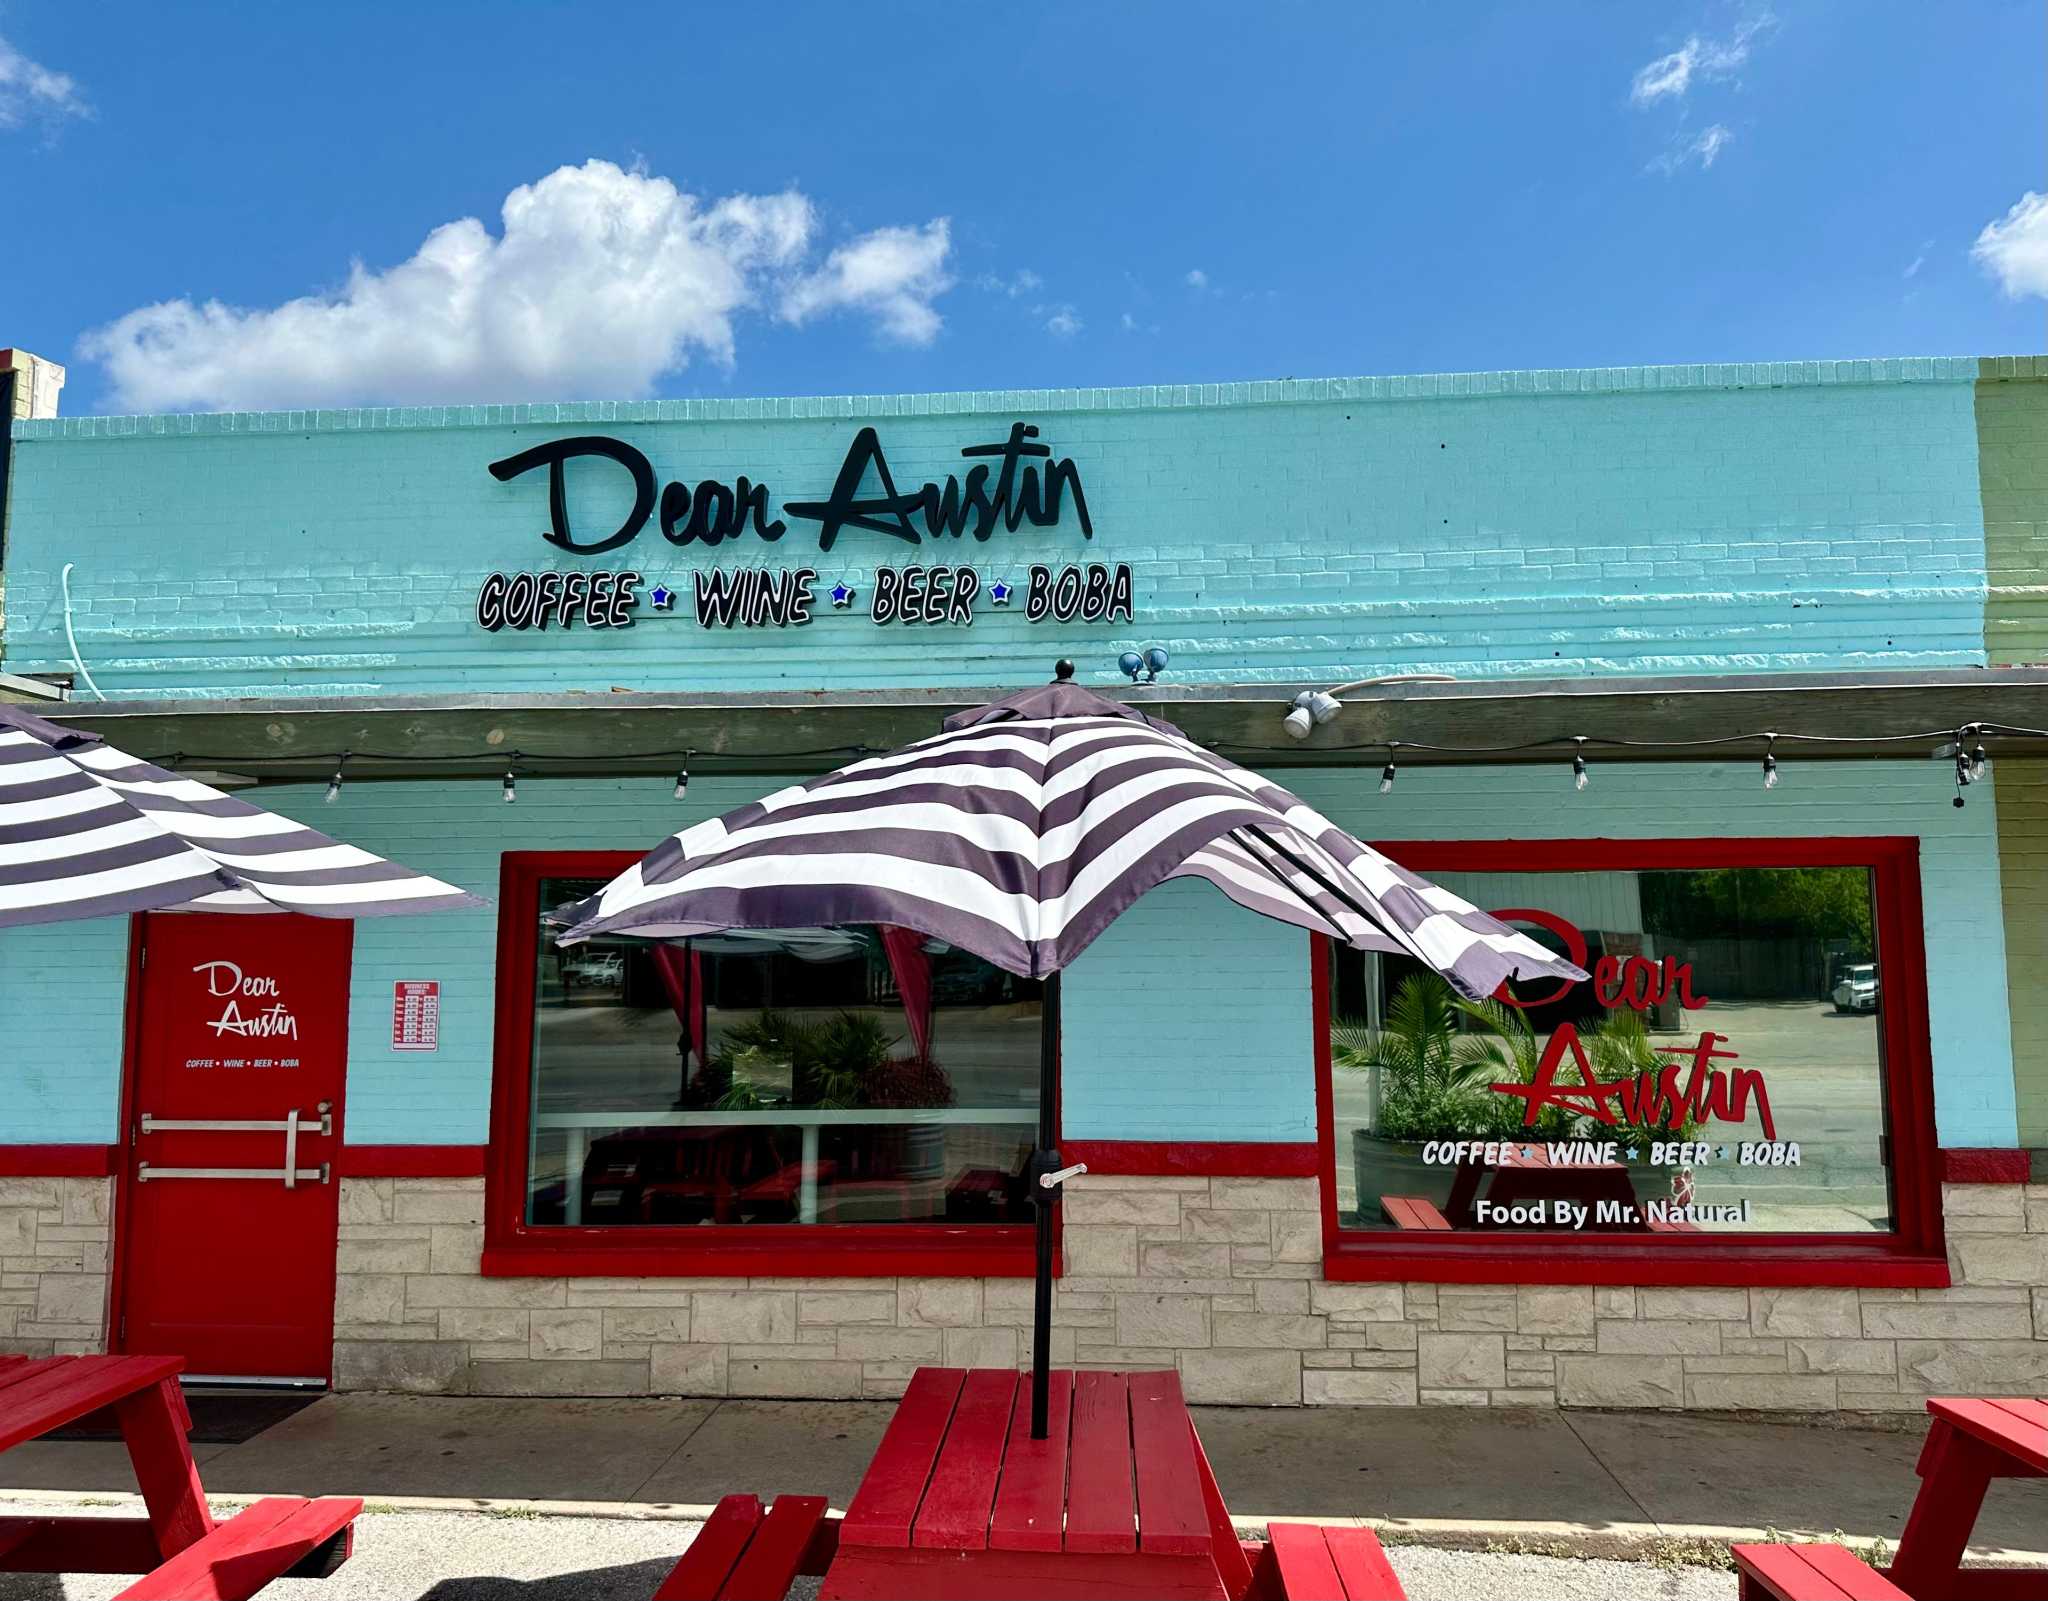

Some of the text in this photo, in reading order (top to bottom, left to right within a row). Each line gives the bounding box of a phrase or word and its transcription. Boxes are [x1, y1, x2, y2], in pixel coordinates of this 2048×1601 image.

[488, 422, 1093, 555] Dear Austin
[475, 563, 1133, 632] COFFEE WINE BEER BOBA
[192, 960, 281, 997] Dear
[206, 1000, 298, 1041] Austin
[185, 1058, 300, 1069] COFFEE WINE BEER BOBA
[1489, 1021, 1776, 1142] Austin
[1421, 1140, 1802, 1166] COFFEE WINE BEER BOBA
[1476, 1199, 1752, 1230] Food By Mr. Natural
